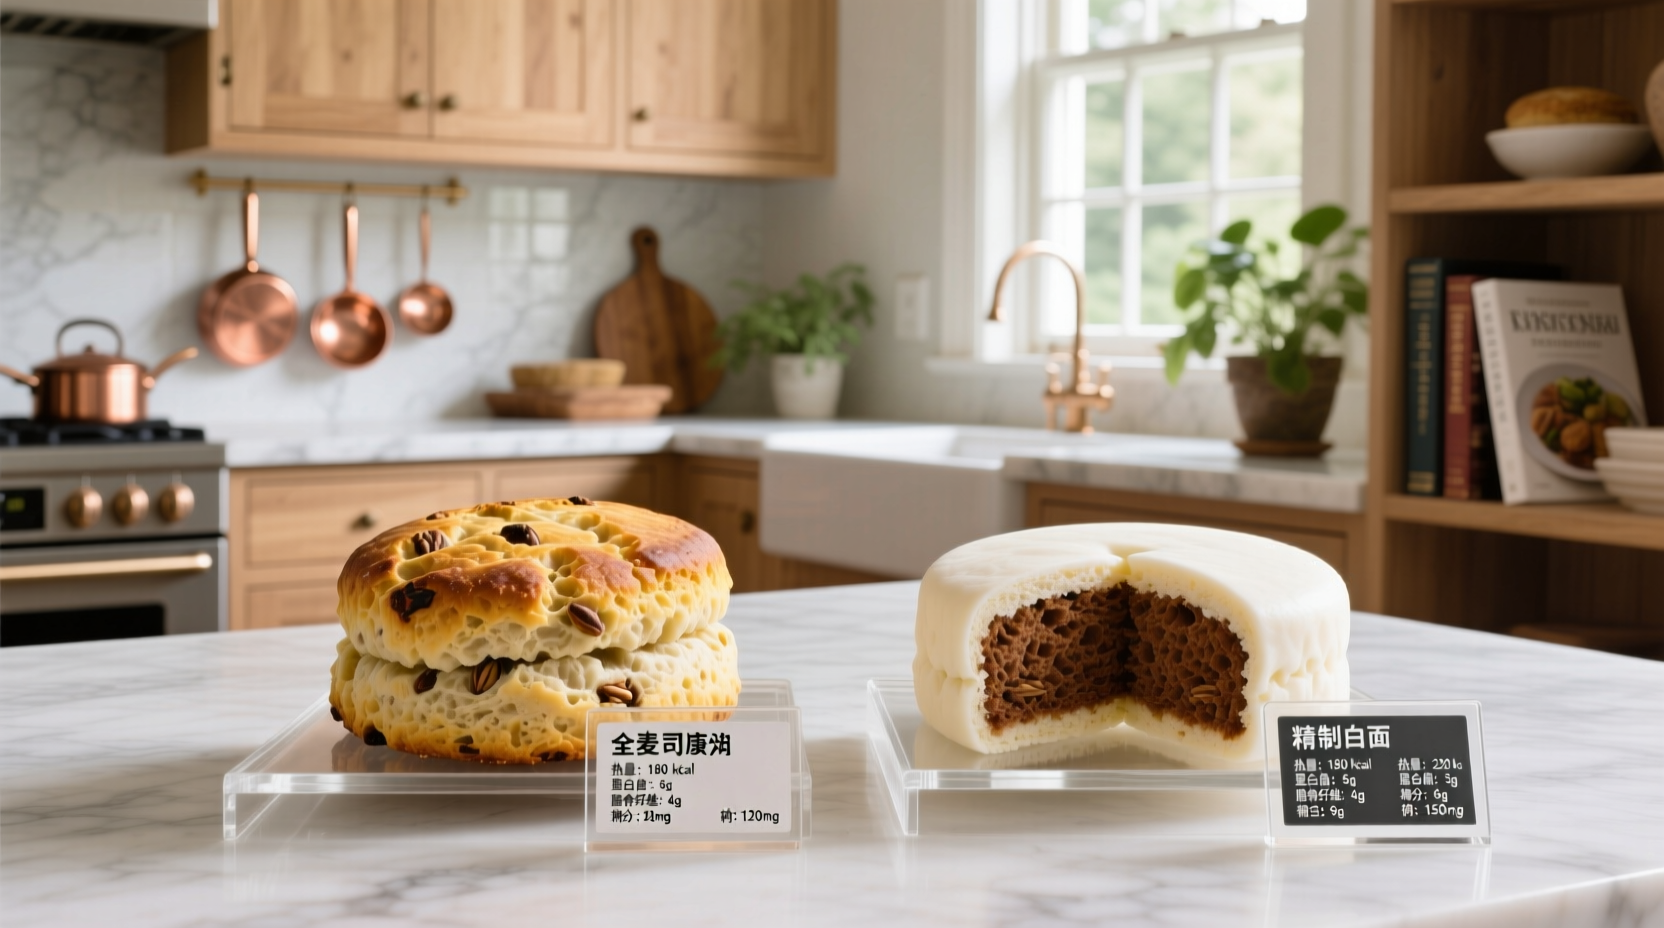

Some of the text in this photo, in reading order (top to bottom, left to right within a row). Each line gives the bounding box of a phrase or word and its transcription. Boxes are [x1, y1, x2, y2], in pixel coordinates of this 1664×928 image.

[1291, 724, 1391, 751] 精制白面
[740, 809, 780, 825] 120mg
[1329, 805, 1345, 819] 9g
